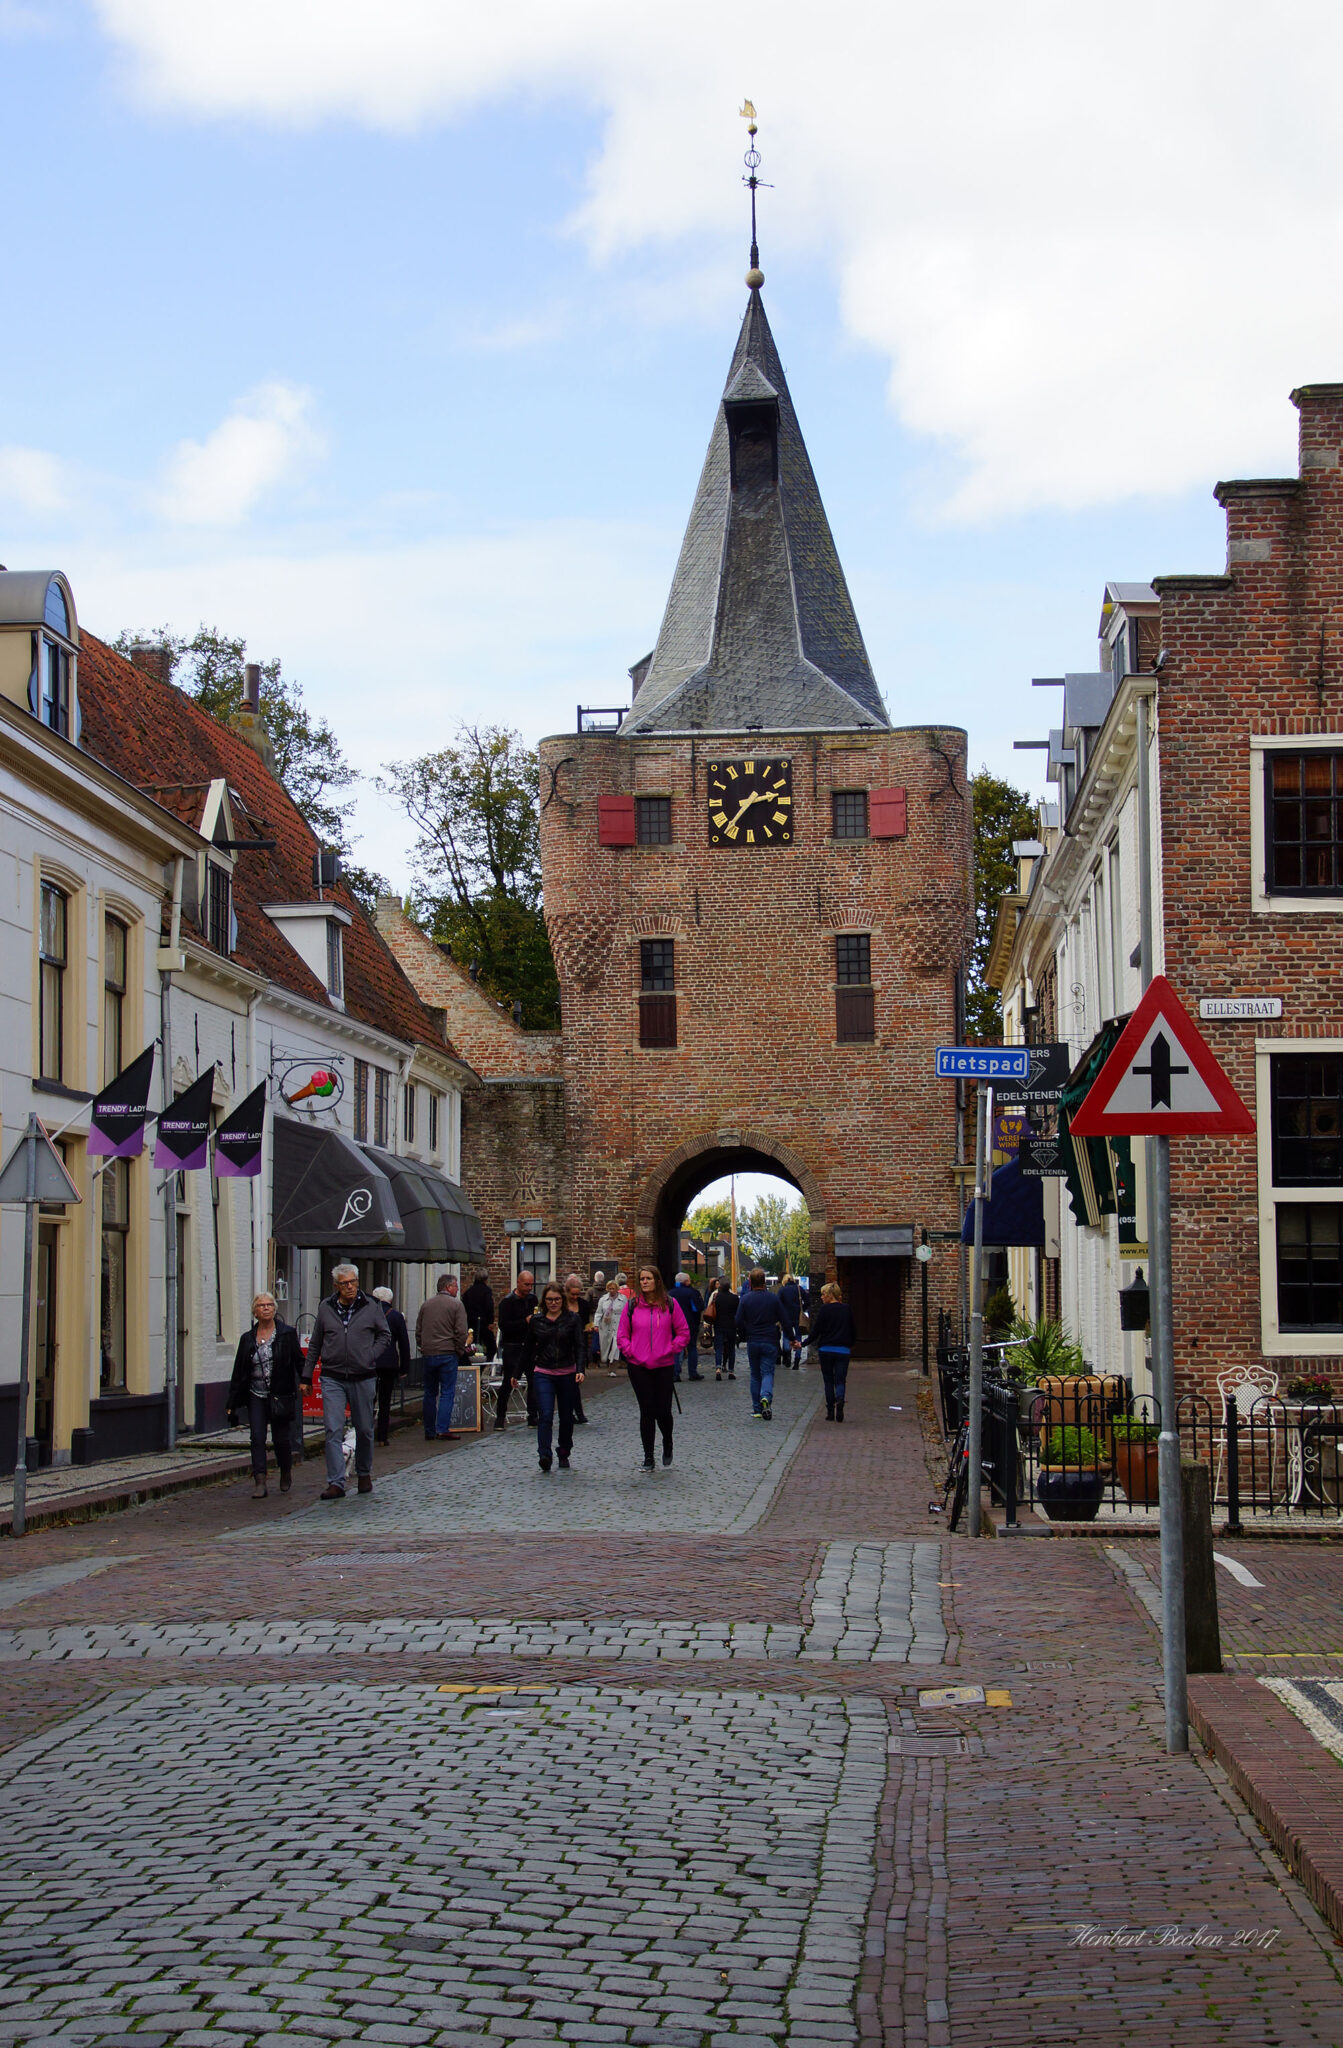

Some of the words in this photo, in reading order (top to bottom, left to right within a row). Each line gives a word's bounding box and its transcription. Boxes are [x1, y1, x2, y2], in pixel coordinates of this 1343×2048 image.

[1206, 1002, 1275, 1015] ELLESTRAAT
[941, 1055, 1024, 1074] fietspad
[996, 1090, 1063, 1101] EDELSTENEN
[98, 1105, 128, 1113] TRENDY
[128, 1104, 146, 1113] LADY
[1119, 1216, 1136, 1225] (052
